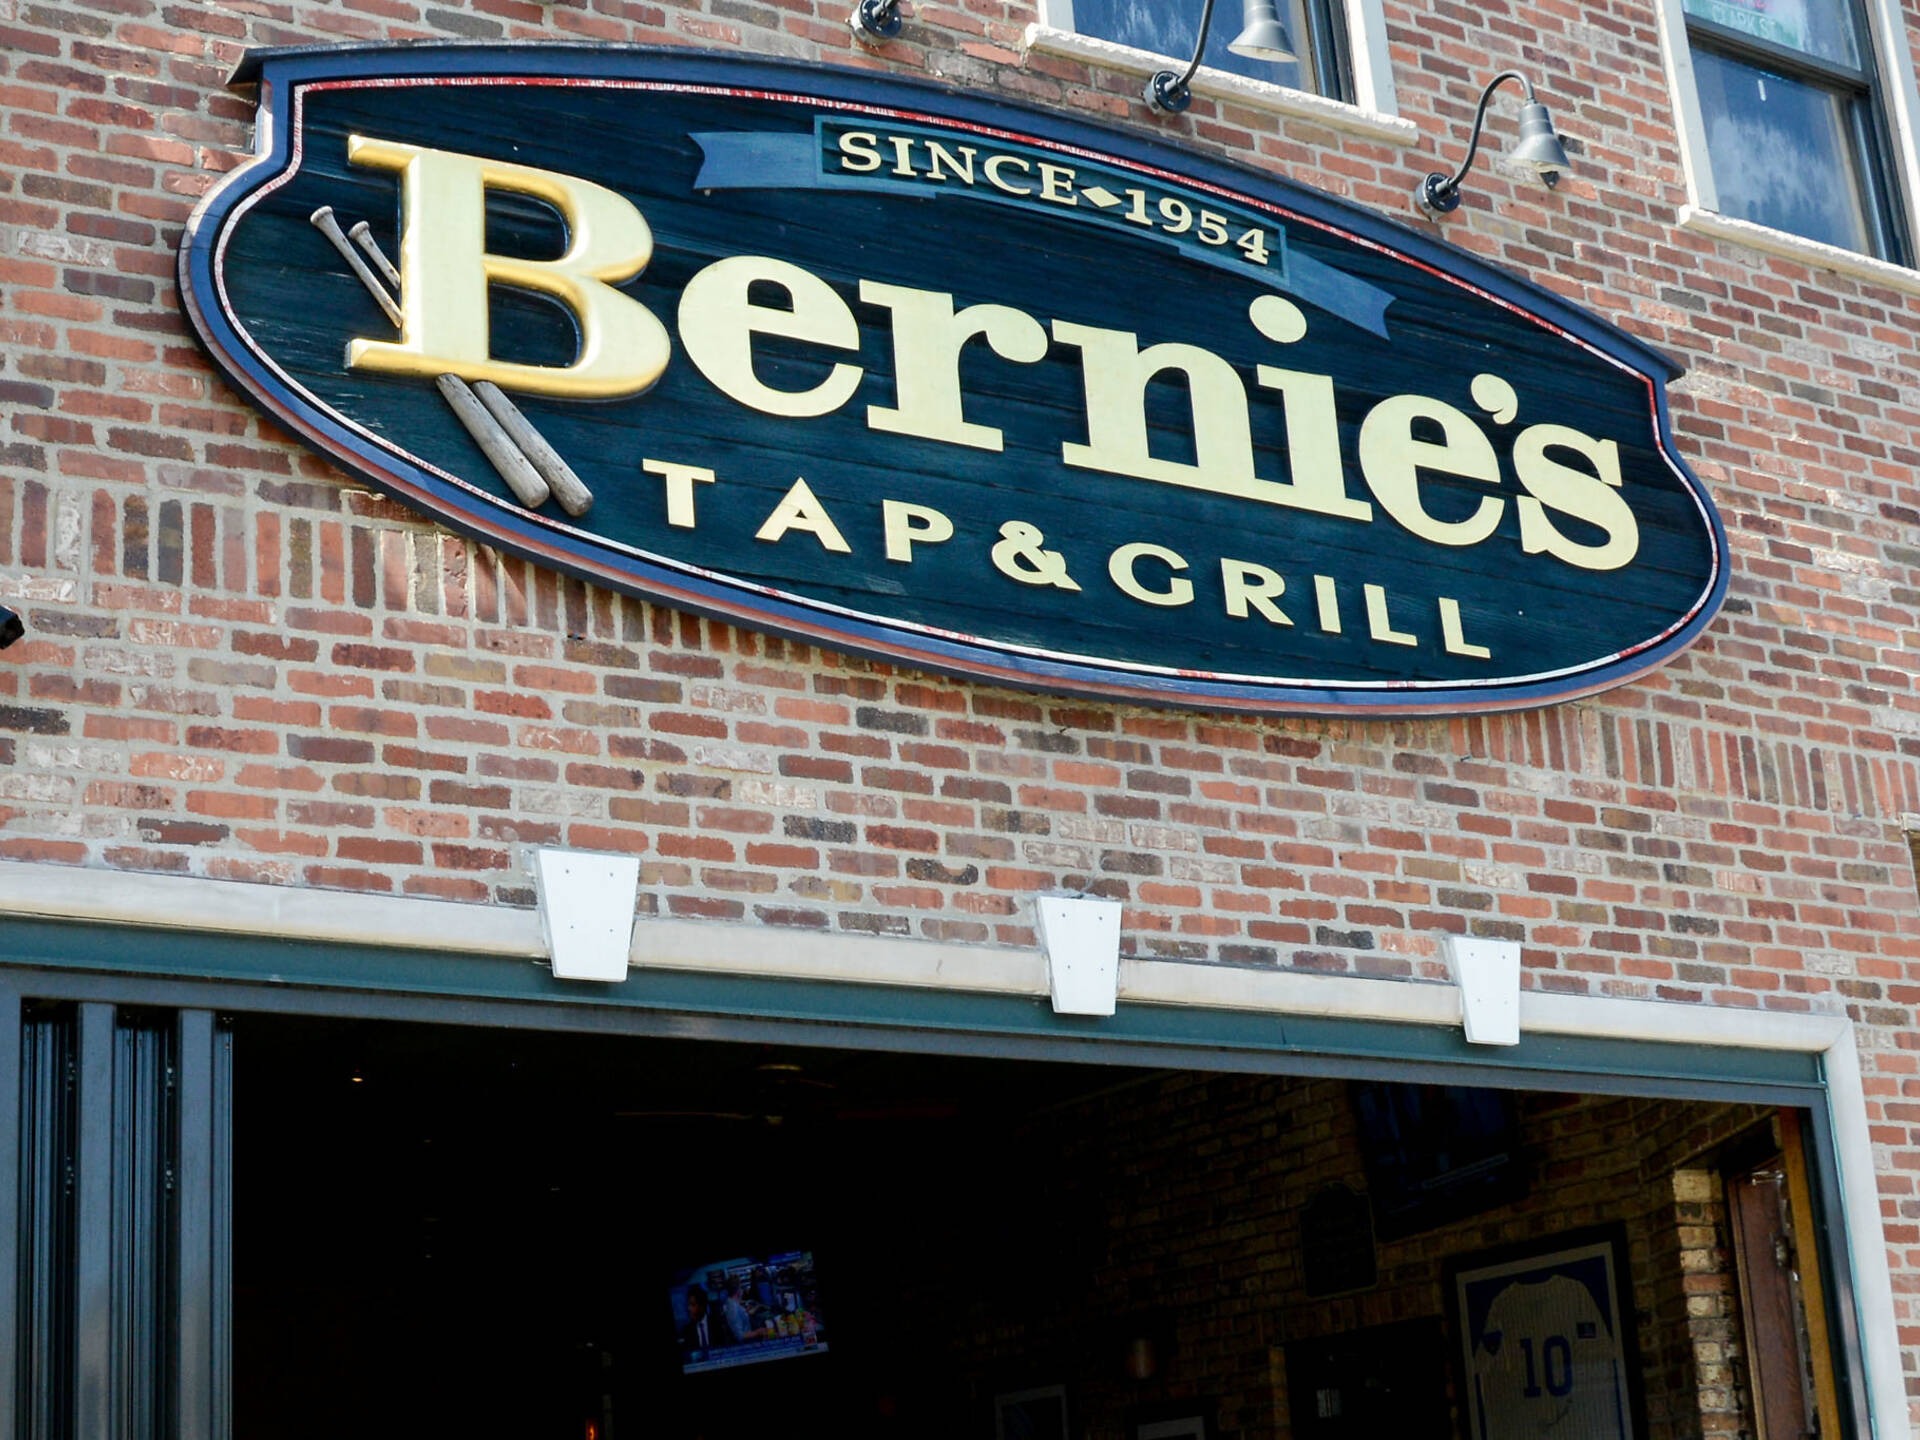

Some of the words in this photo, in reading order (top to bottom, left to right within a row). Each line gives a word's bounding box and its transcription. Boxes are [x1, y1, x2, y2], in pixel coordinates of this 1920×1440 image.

[839, 131, 1078, 206] SINCE
[1124, 188, 1269, 265] 1954
[344, 134, 1640, 571] Bernie's
[642, 458, 954, 563] TAP
[991, 520, 1082, 592] &
[1108, 542, 1491, 659] GRILL
[1519, 1335, 1574, 1399] 10
